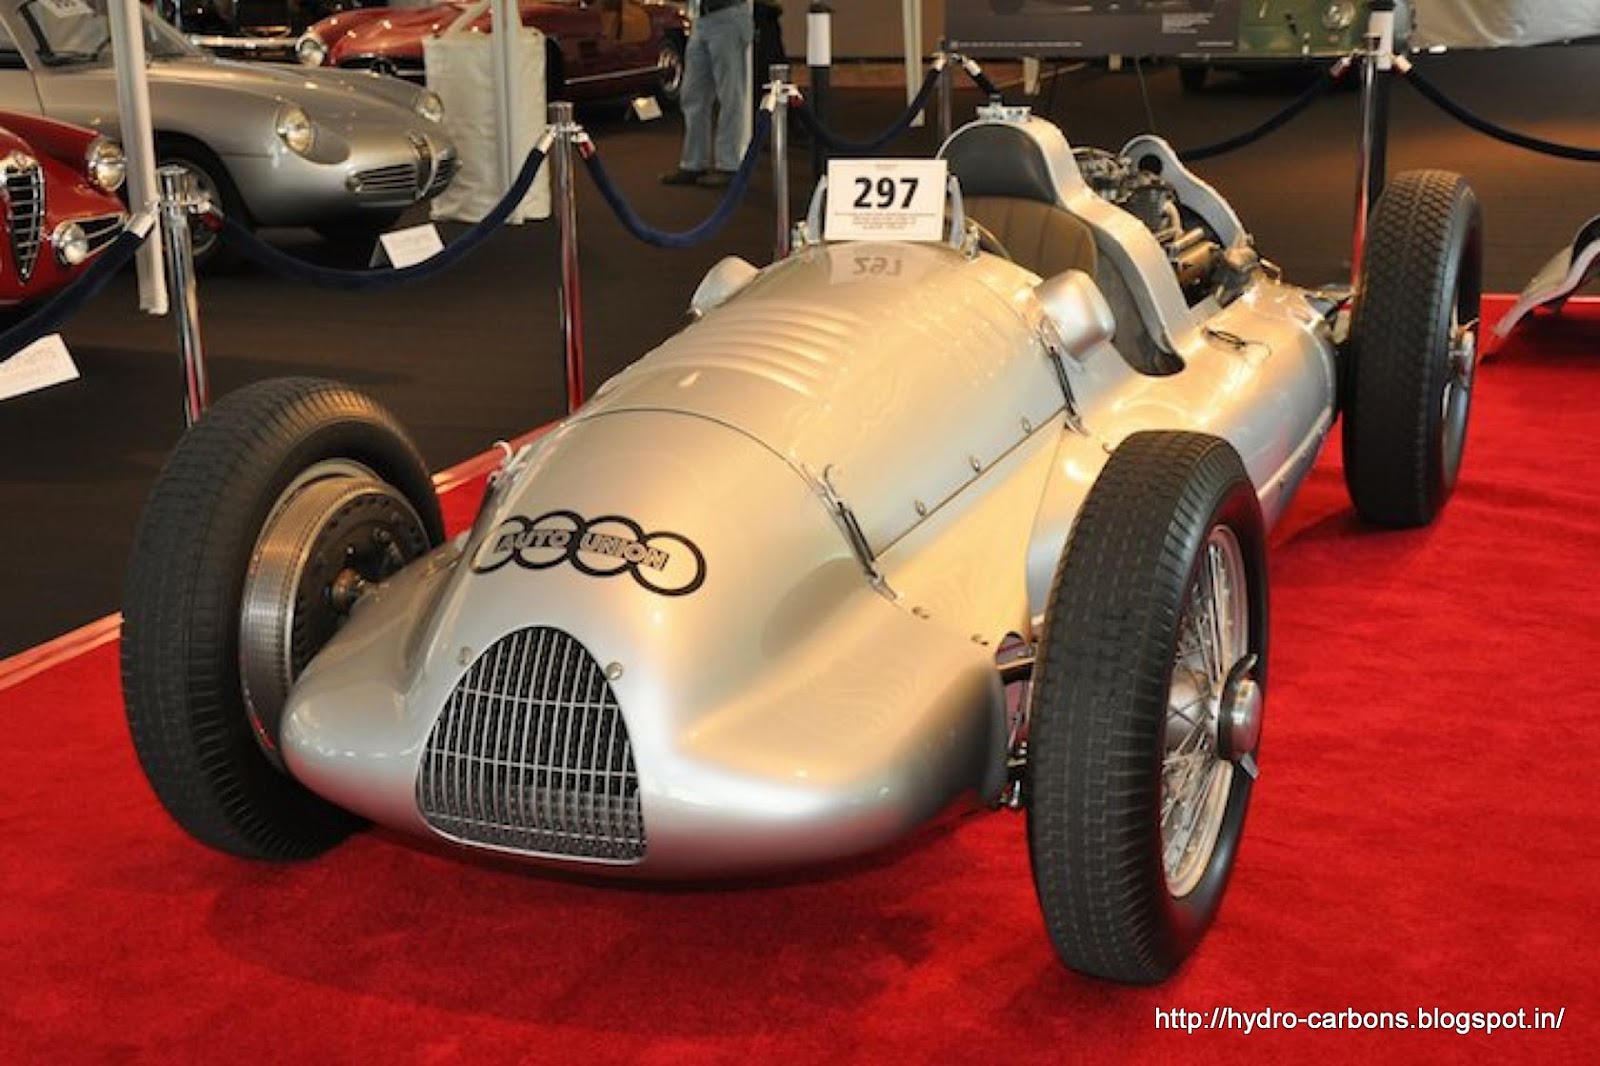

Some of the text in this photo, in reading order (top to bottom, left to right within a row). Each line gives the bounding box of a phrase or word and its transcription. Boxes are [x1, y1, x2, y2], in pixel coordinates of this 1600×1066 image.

[853, 177, 919, 209] 297
[494, 529, 670, 572] AUTO UNION
